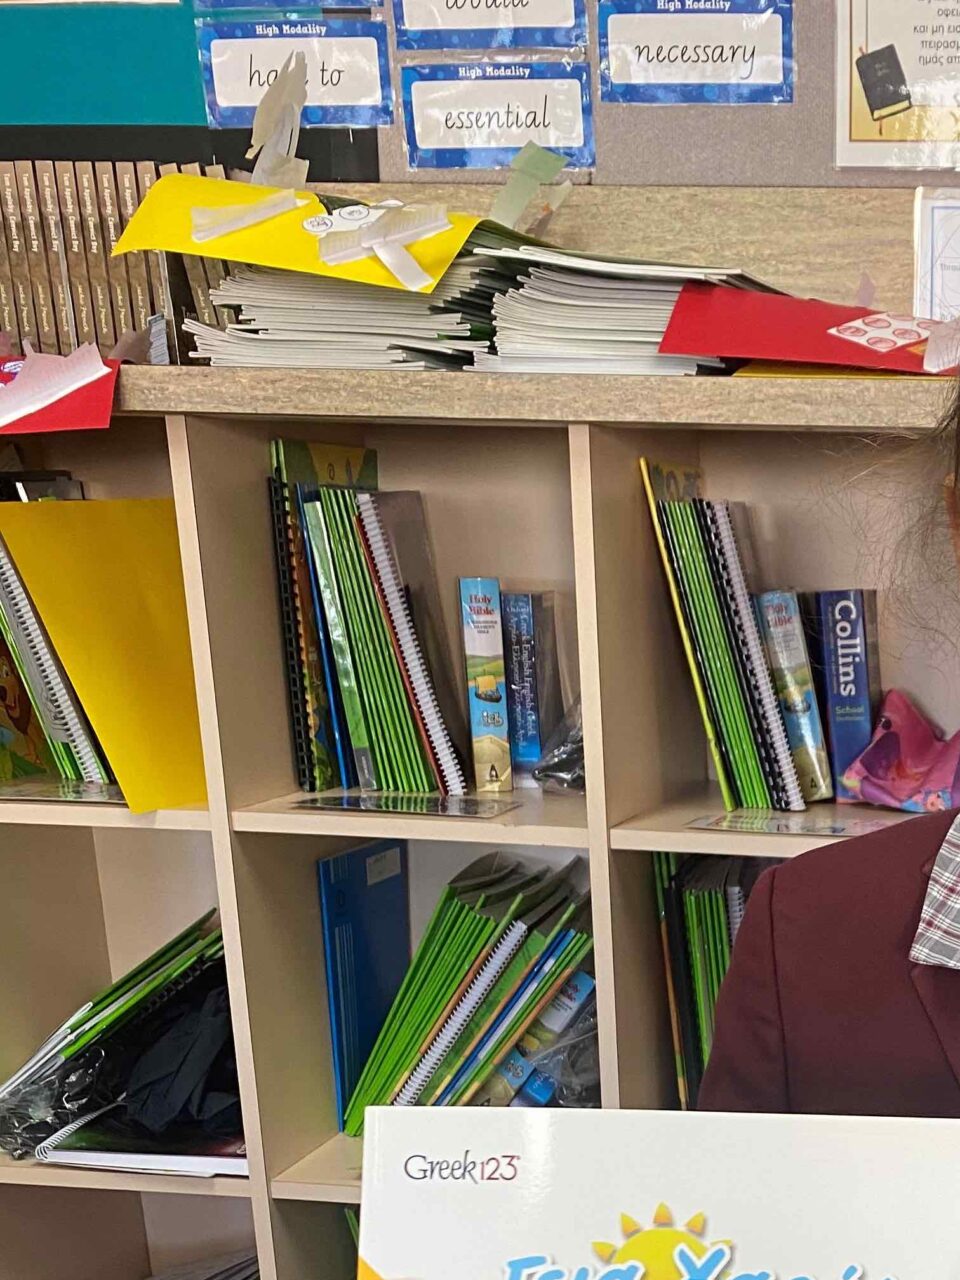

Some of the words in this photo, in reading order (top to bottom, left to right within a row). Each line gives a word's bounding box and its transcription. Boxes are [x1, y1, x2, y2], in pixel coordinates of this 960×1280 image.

[656, 0, 682, 11] High
[685, 0, 732, 12] Modality
[255, 25, 280, 36] High
[282, 24, 328, 36] Modality
[320, 60, 346, 87] to
[458, 67, 483, 80] High
[486, 66, 531, 78] Modality
[635, 44, 756, 80] necessary
[445, 94, 551, 130] essential
[834, 600, 861, 697] Collins
